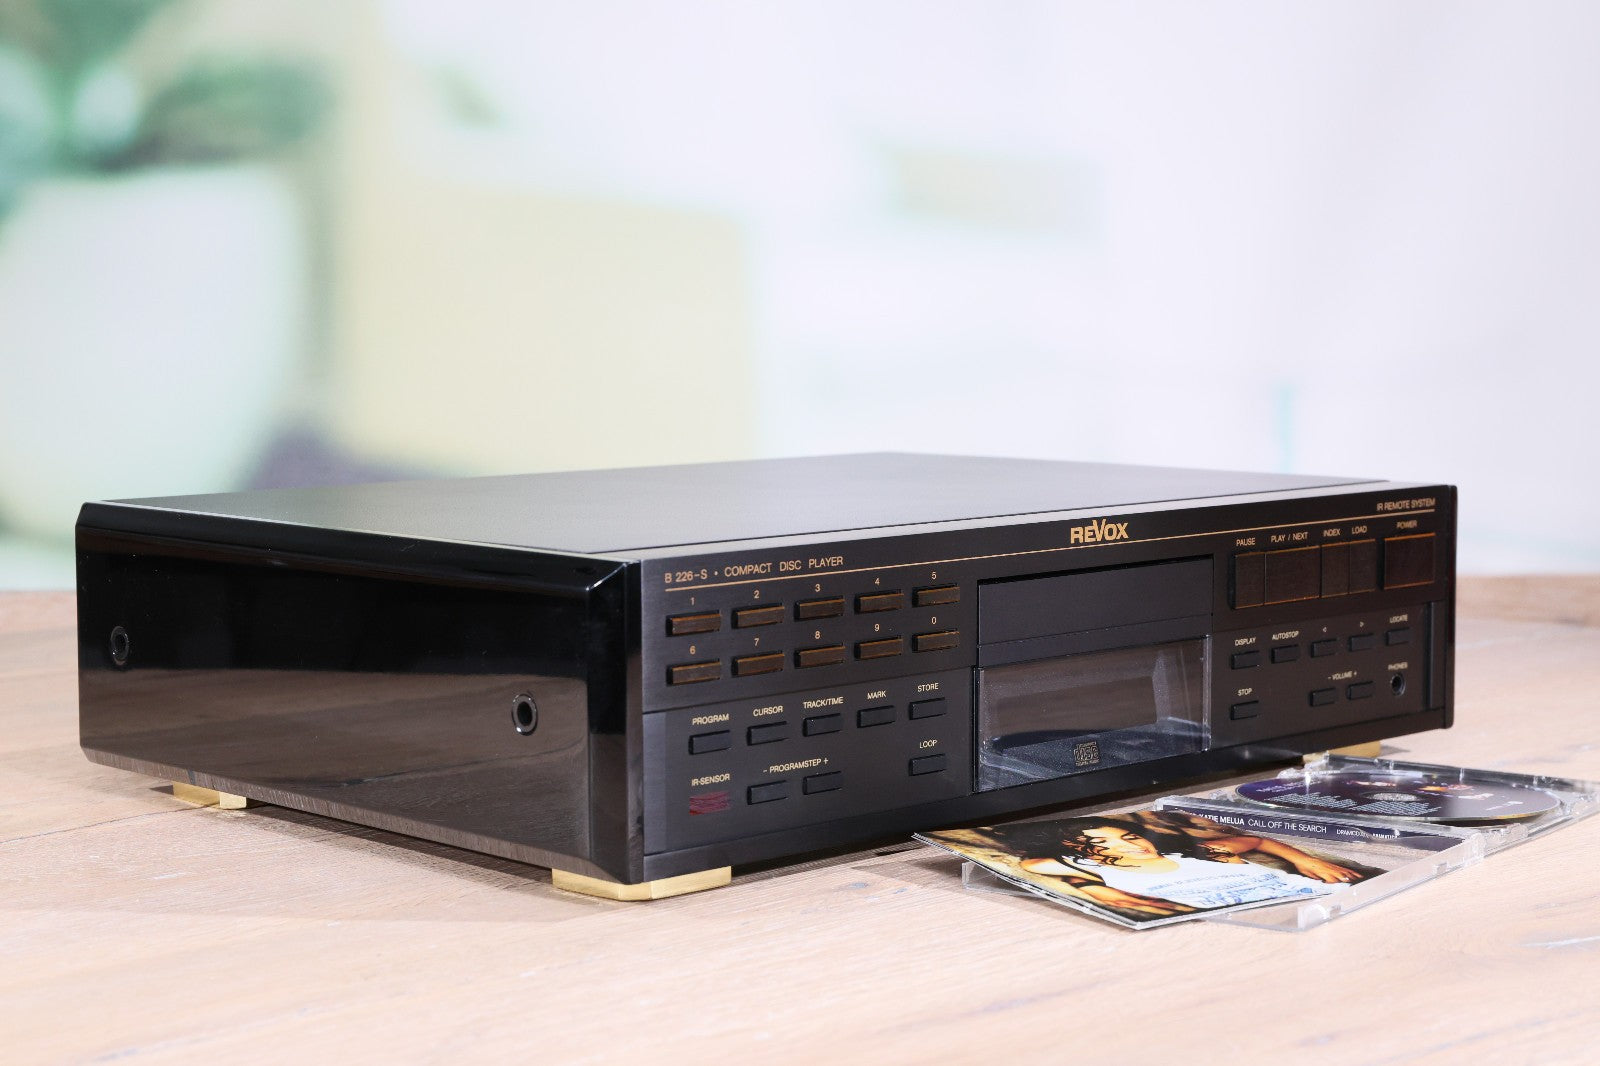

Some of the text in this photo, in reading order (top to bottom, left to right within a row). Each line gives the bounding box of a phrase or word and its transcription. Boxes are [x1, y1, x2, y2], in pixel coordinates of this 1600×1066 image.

[1376, 498, 1436, 511] IR REMOTE SYSTEM
[1397, 520, 1417, 529] POWER
[1323, 528, 1341, 537] INDEX
[1352, 525, 1367, 535] LOAD
[1236, 537, 1256, 547] PAUSE
[1271, 534, 1286, 543] PLAY
[1293, 531, 1308, 541] NEXT
[664, 556, 844, 584] B 226-S COMPACT DISC PLAYER
[931, 571, 937, 581] 5
[874, 577, 881, 587] 4
[815, 583, 821, 593] 3
[753, 590, 760, 600] 2
[874, 623, 880, 633] 9
[815, 630, 821, 640] 8
[1271, 631, 1300, 641] AUTOSTOP
[754, 638, 760, 647] 7
[1234, 637, 1256, 647] DISPLAY
[689, 645, 696, 656] 6
[1332, 671, 1353, 681] VOLUME
[917, 682, 940, 693] STORE
[1237, 687, 1253, 696] STOP
[867, 690, 887, 700] MARK
[803, 696, 844, 710] TRACK/TIME
[753, 705, 784, 717] CURSOR
[692, 713, 730, 726] PROGRAM
[919, 739, 938, 749] LOOP
[769, 758, 822, 774] PROGRAMSTEP
[691, 773, 731, 787] IR-SENSOR
[1219, 815, 1245, 826] MELUA
[1247, 818, 1267, 828] CALL
[1267, 820, 1283, 829] OFF
[1284, 822, 1298, 831] THE
[1298, 823, 1327, 834] SEARCH
